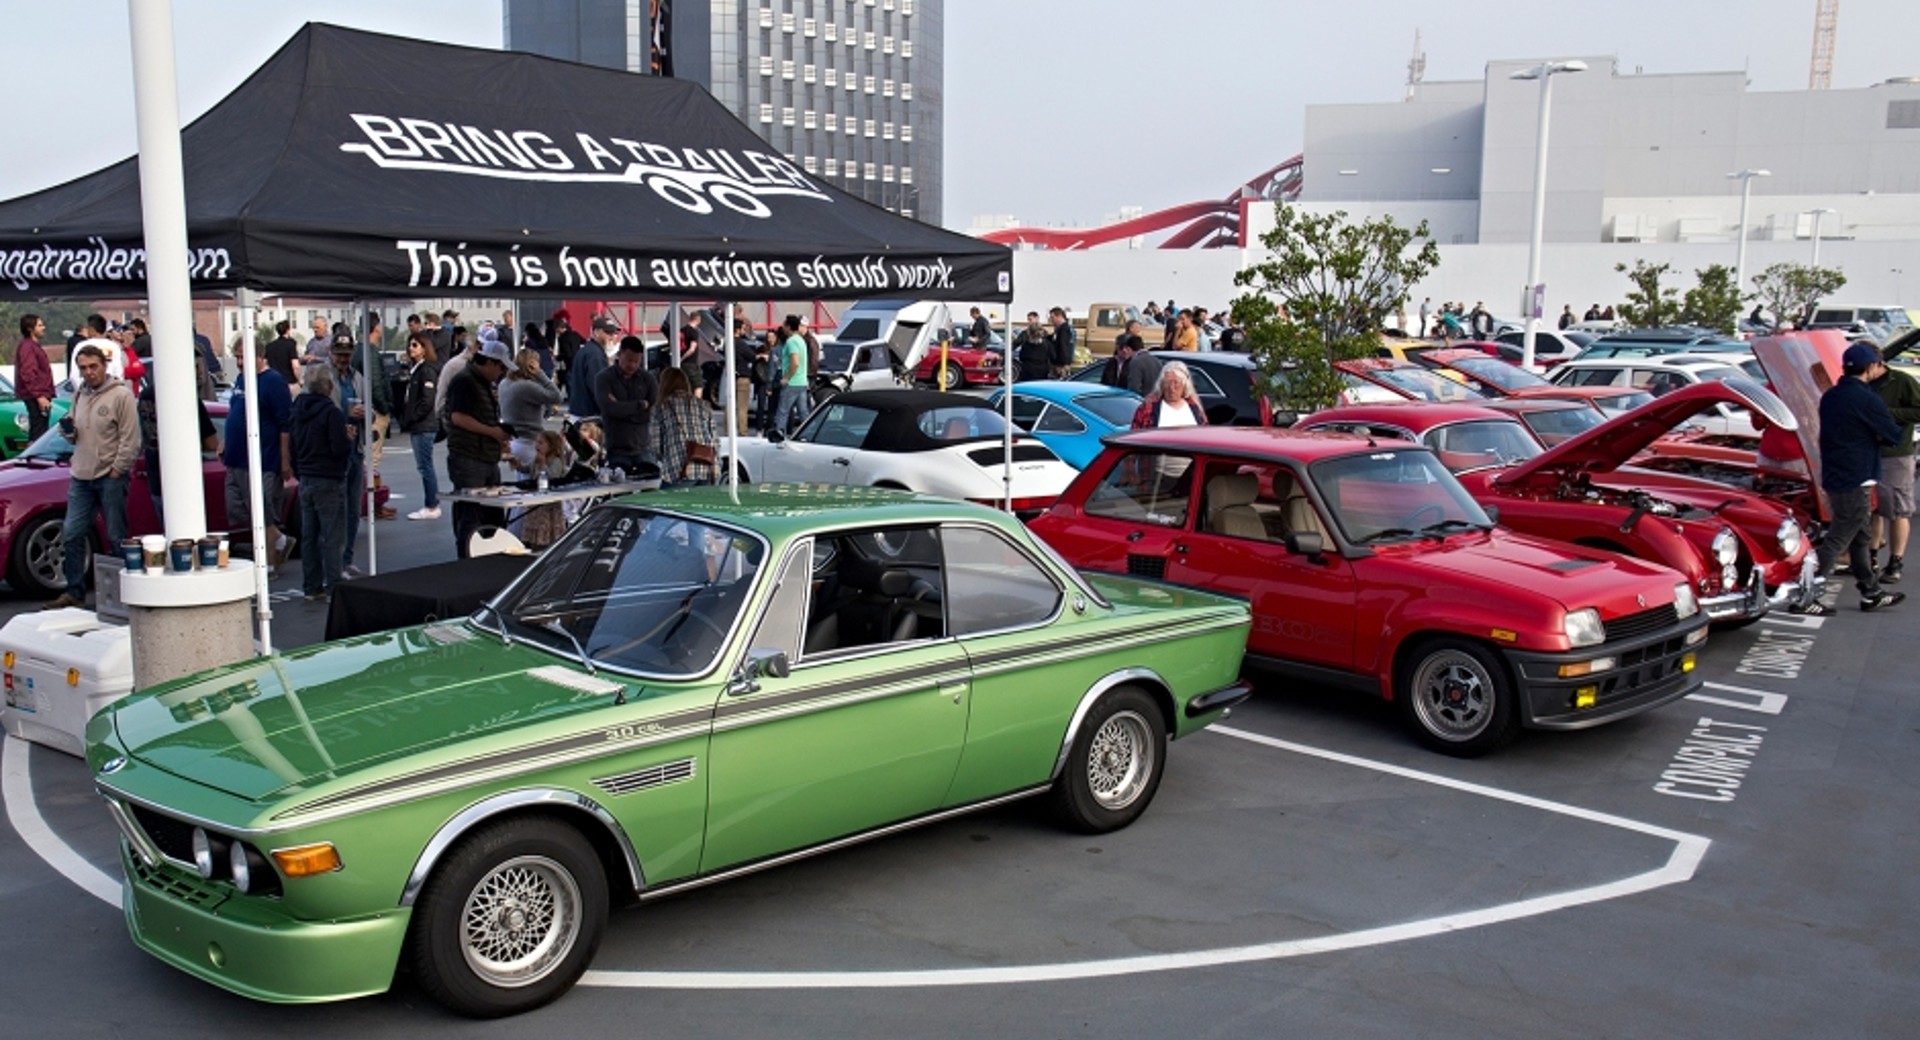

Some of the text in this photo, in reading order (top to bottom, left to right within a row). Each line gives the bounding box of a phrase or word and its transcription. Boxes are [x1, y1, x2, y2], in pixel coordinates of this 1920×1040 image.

[349, 113, 822, 193] BRING A TRAILER
[396, 240, 498, 287] This
[510, 244, 549, 287] is
[558, 246, 640, 287] how
[650, 251, 792, 288] auctions
[797, 254, 889, 289] should
[892, 257, 956, 290] work.
[1734, 629, 1817, 679] COMPACT
[1652, 716, 1768, 801] COMPACT
